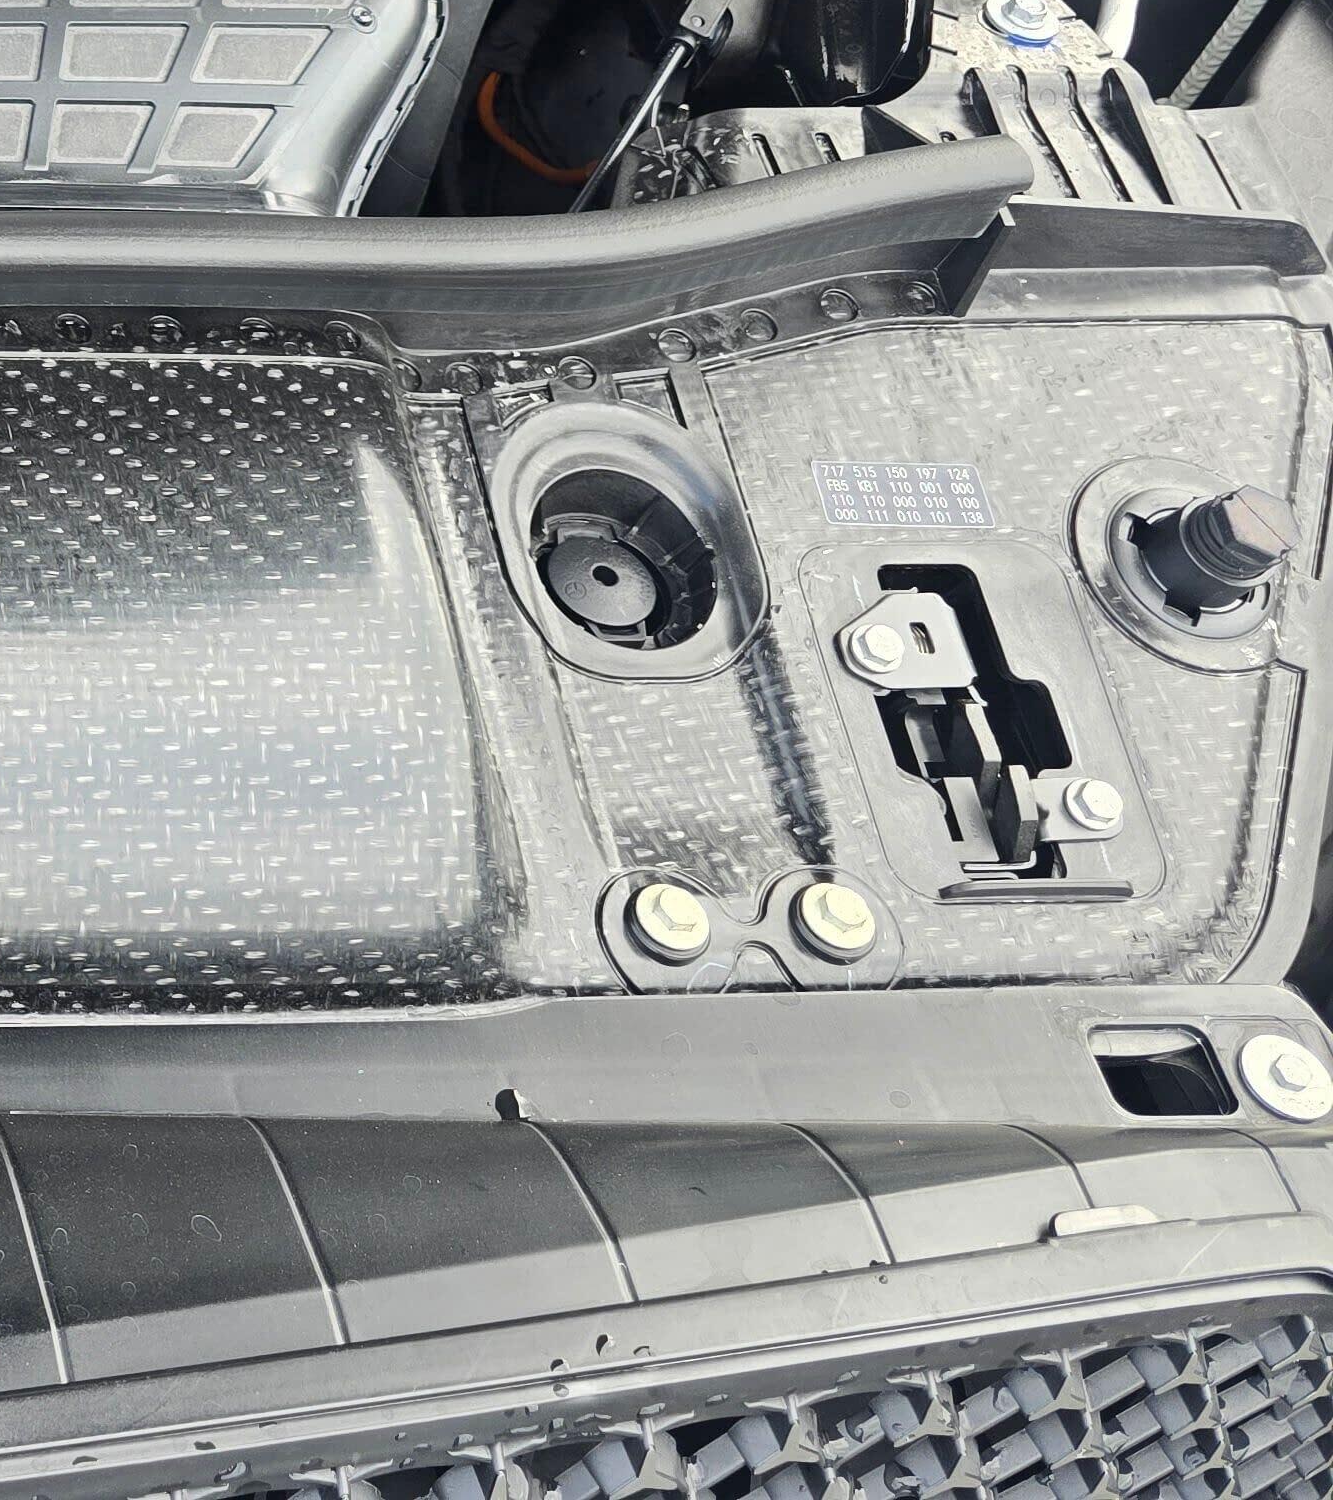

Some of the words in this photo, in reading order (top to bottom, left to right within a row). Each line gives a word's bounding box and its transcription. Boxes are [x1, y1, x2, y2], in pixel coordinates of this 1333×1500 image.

[821, 465, 845, 477] 717
[852, 466, 877, 478] 515
[885, 466, 908, 479] 150
[916, 467, 937, 480] 197
[947, 468, 970, 481] 124
[826, 479, 849, 492] FB5
[857, 480, 879, 492] KB1
[889, 481, 912, 494] 110
[919, 482, 943, 494] 001
[951, 482, 975, 495] 000
[832, 494, 855, 507] 110
[863, 495, 886, 507] 110
[893, 495, 917, 508] 000
[924, 496, 948, 509] 010
[956, 497, 980, 509] 100
[835, 508, 859, 521] 000
[867, 510, 889, 522] 111
[896, 510, 922, 523] 010
[929, 511, 952, 523] 101
[961, 511, 984, 524] 138
